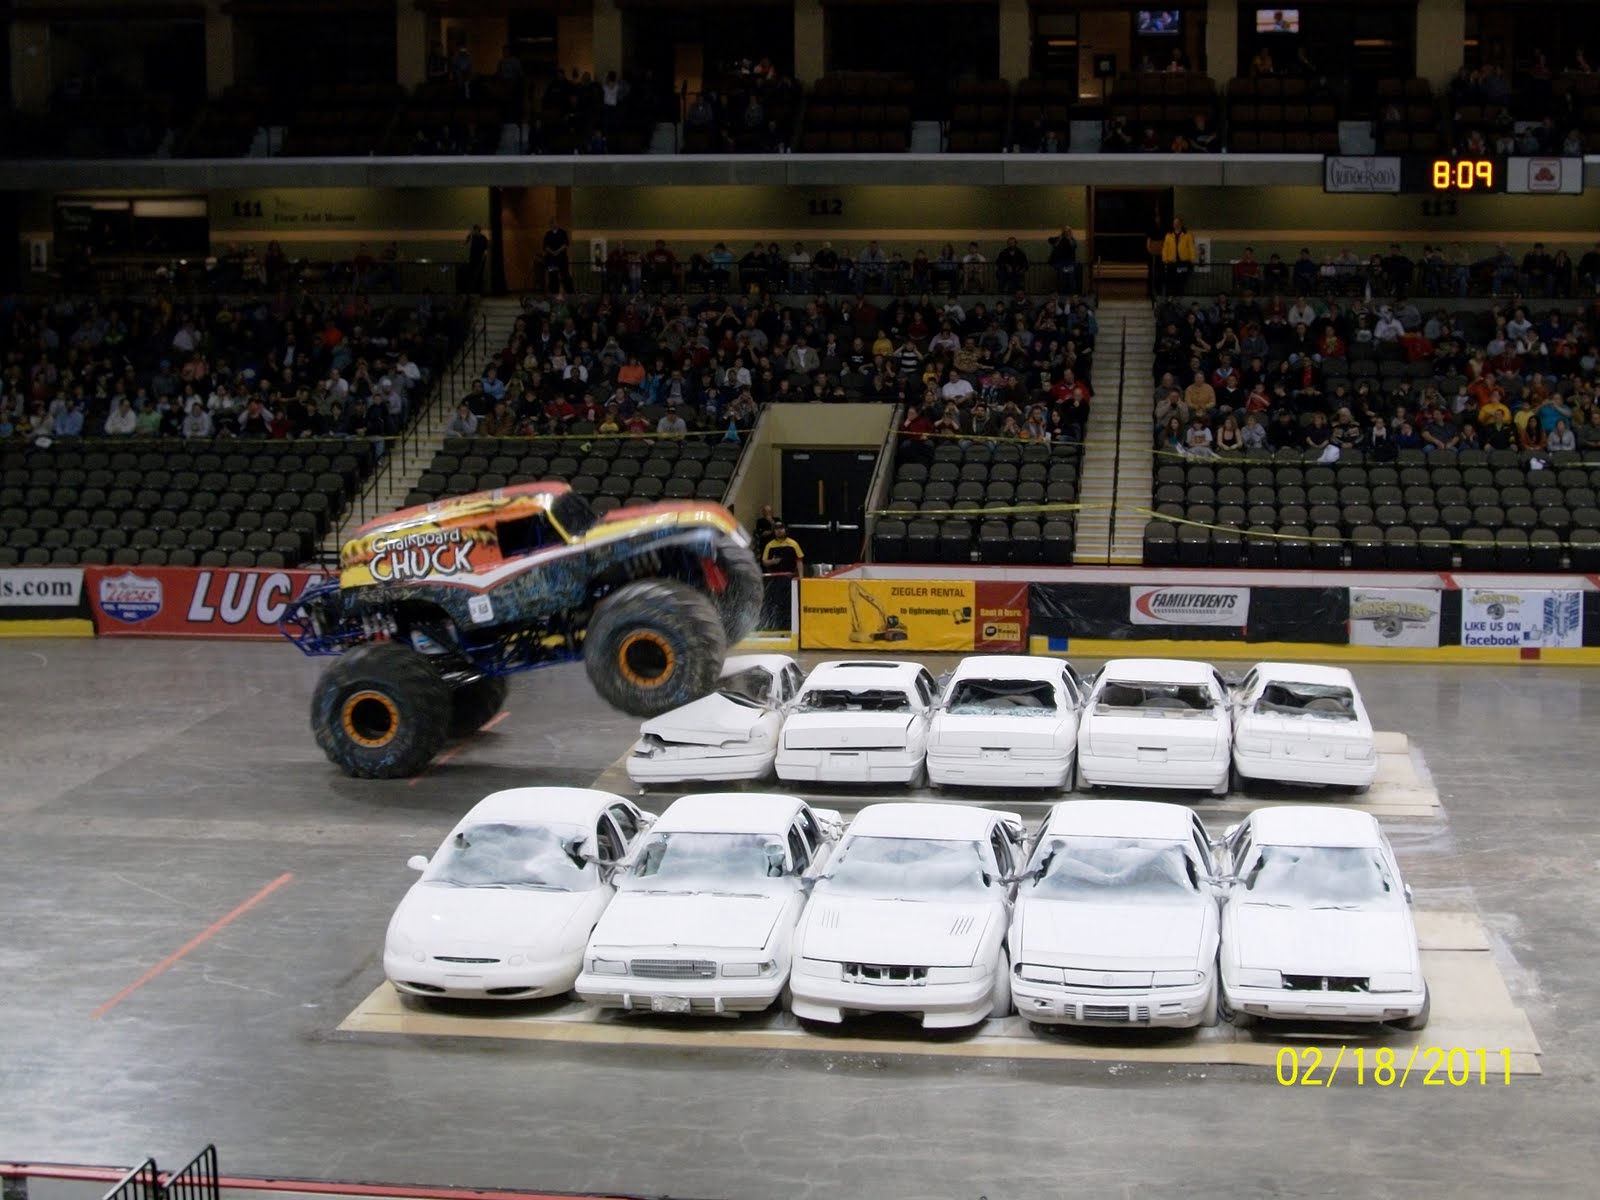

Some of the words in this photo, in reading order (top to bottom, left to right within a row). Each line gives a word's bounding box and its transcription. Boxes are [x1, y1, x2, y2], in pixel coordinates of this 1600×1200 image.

[1433, 161, 1492, 189] 8:09
[232, 200, 263, 216] 111
[808, 200, 842, 215] 112
[372, 528, 461, 553] Chalkboard
[369, 540, 475, 581] CHUCK
[891, 587, 928, 597] ZIEGLER
[930, 587, 966, 598] RENTAL
[1464, 621, 1487, 631] LIKE
[1489, 621, 1504, 632] US
[1506, 622, 1522, 632] ON
[1465, 634, 1521, 646] facebook
